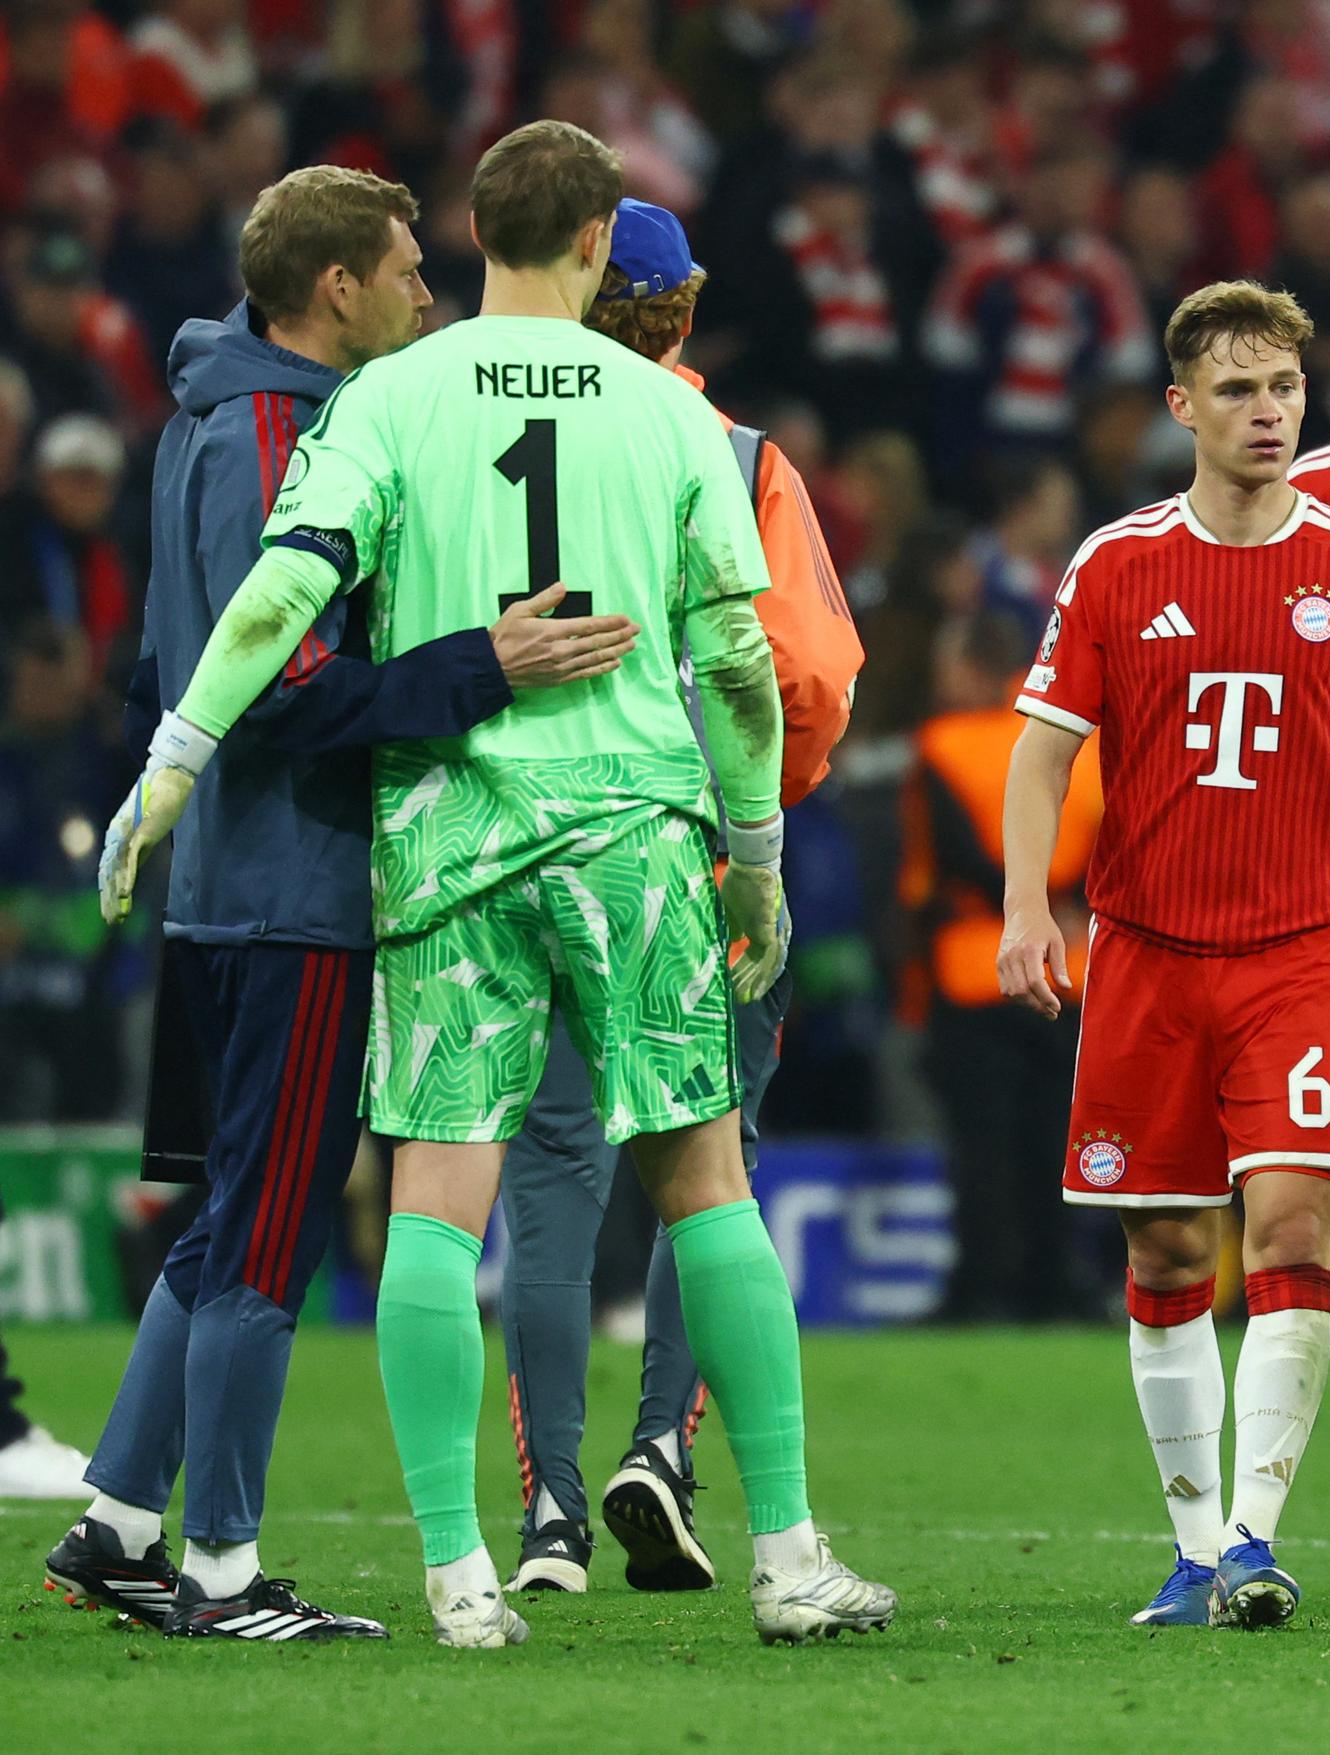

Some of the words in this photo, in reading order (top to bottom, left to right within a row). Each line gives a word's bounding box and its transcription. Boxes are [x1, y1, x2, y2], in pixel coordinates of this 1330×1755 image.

[474, 361, 602, 399] NEUER
[492, 418, 593, 619] 1
[1185, 671, 1284, 790] T
